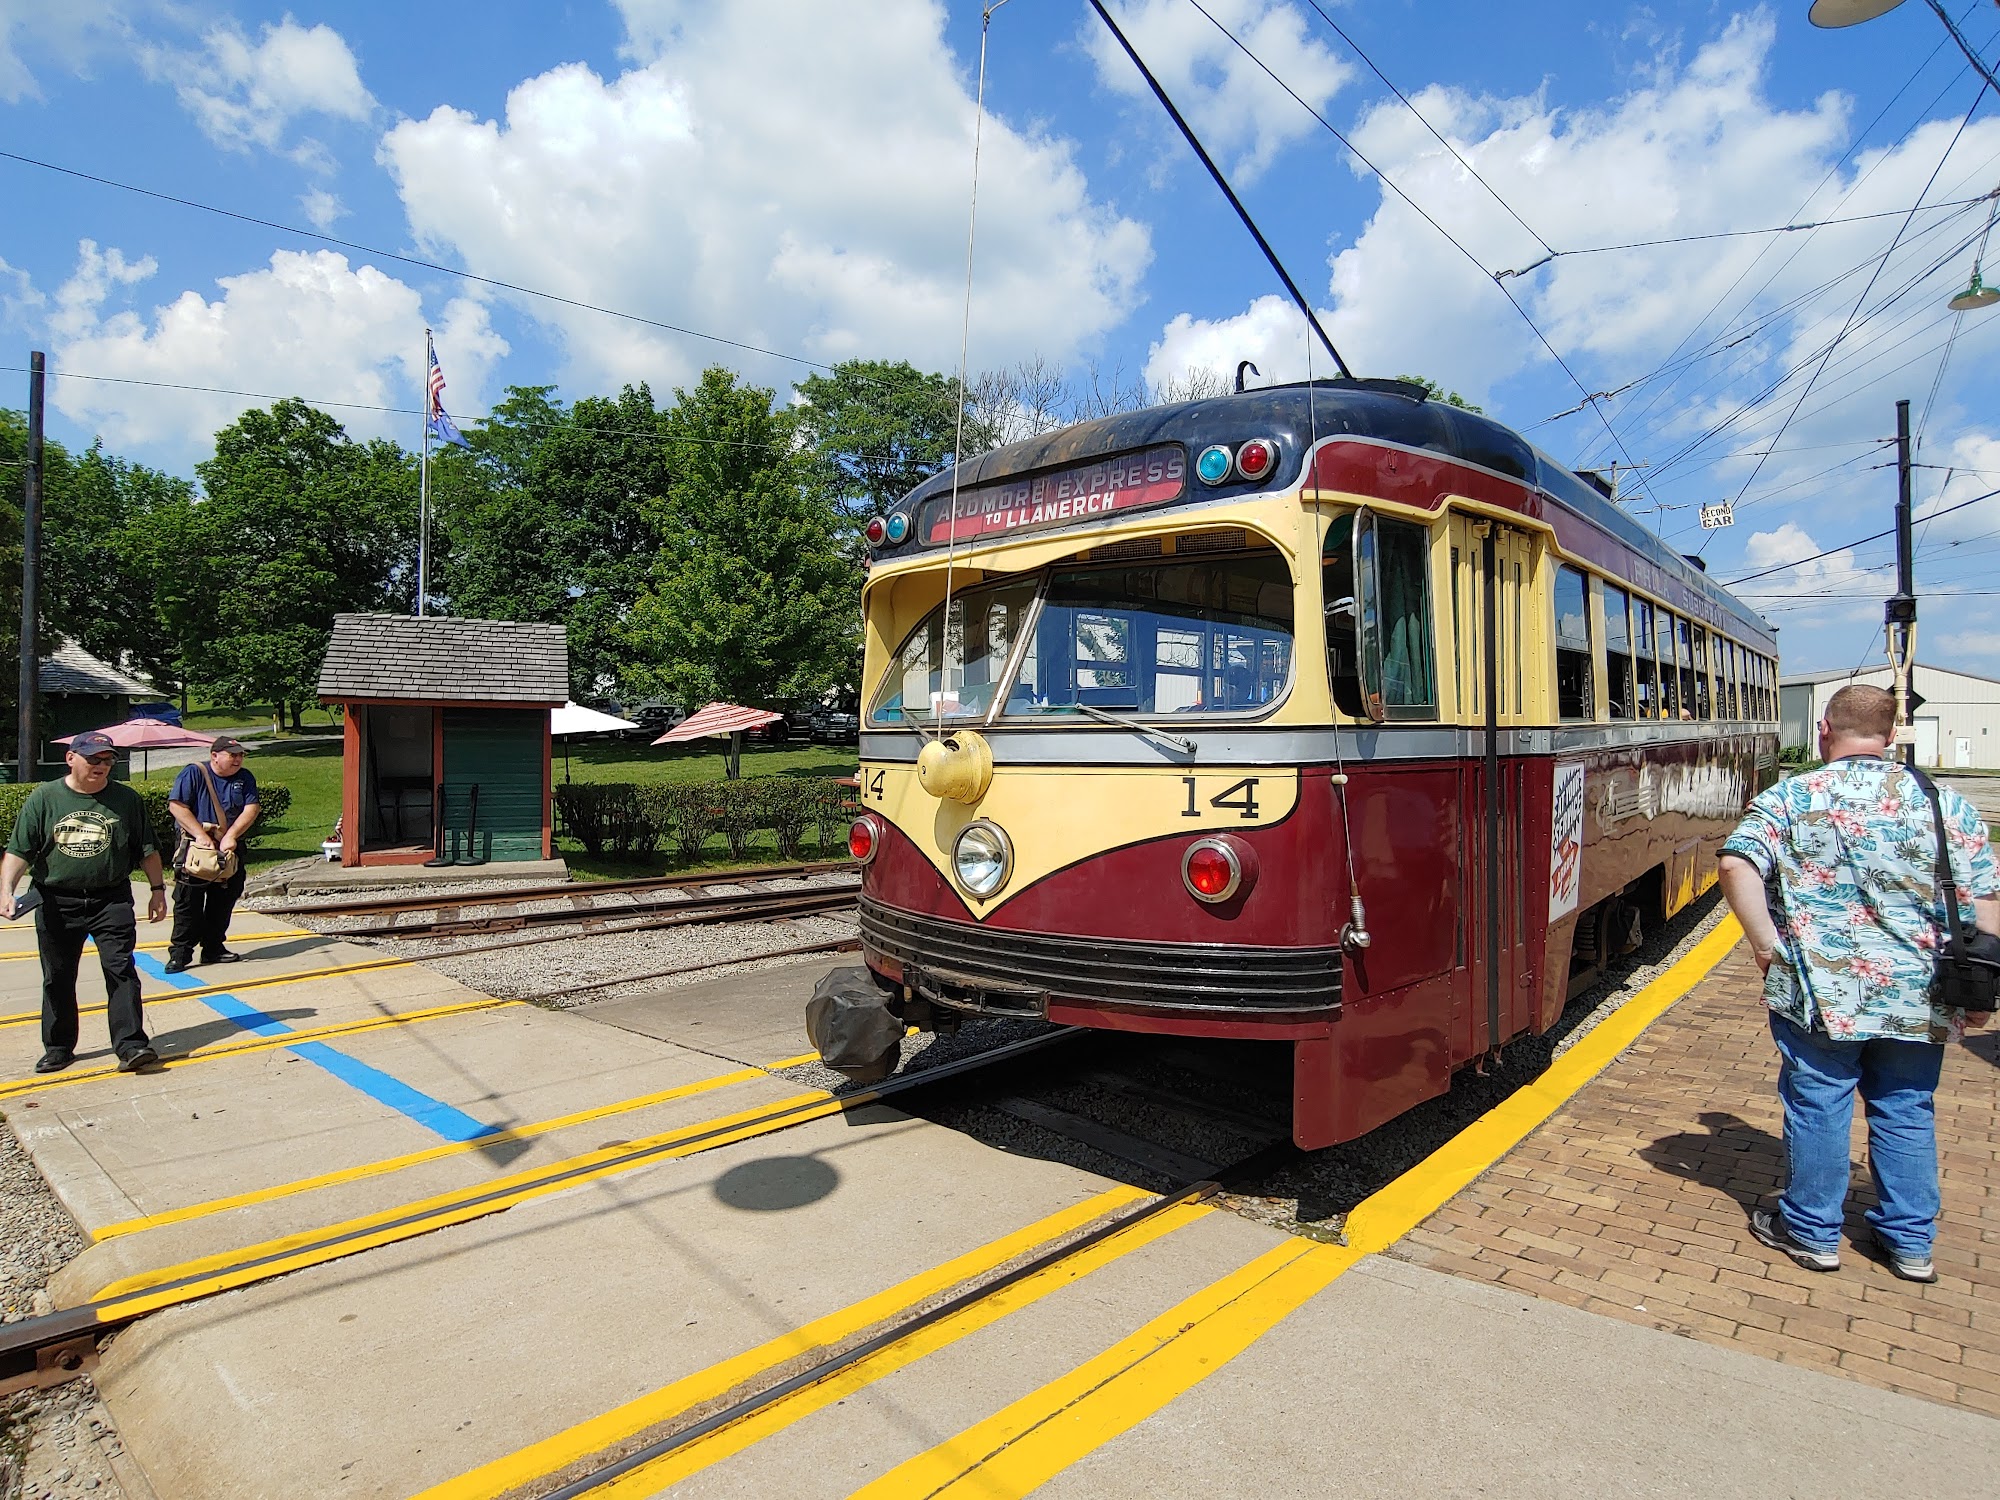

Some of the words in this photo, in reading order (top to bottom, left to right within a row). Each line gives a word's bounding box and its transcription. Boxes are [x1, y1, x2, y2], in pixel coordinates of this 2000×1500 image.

[936, 480, 1043, 523] ARDMORE
[1058, 457, 1183, 499] EXPRESS
[986, 511, 1002, 526] TO
[1005, 491, 1115, 528] LLANERCH
[1701, 506, 1731, 519] SECOND
[1702, 515, 1732, 528] CAR
[863, 768, 884, 801] 14
[1181, 776, 1260, 819] 14
